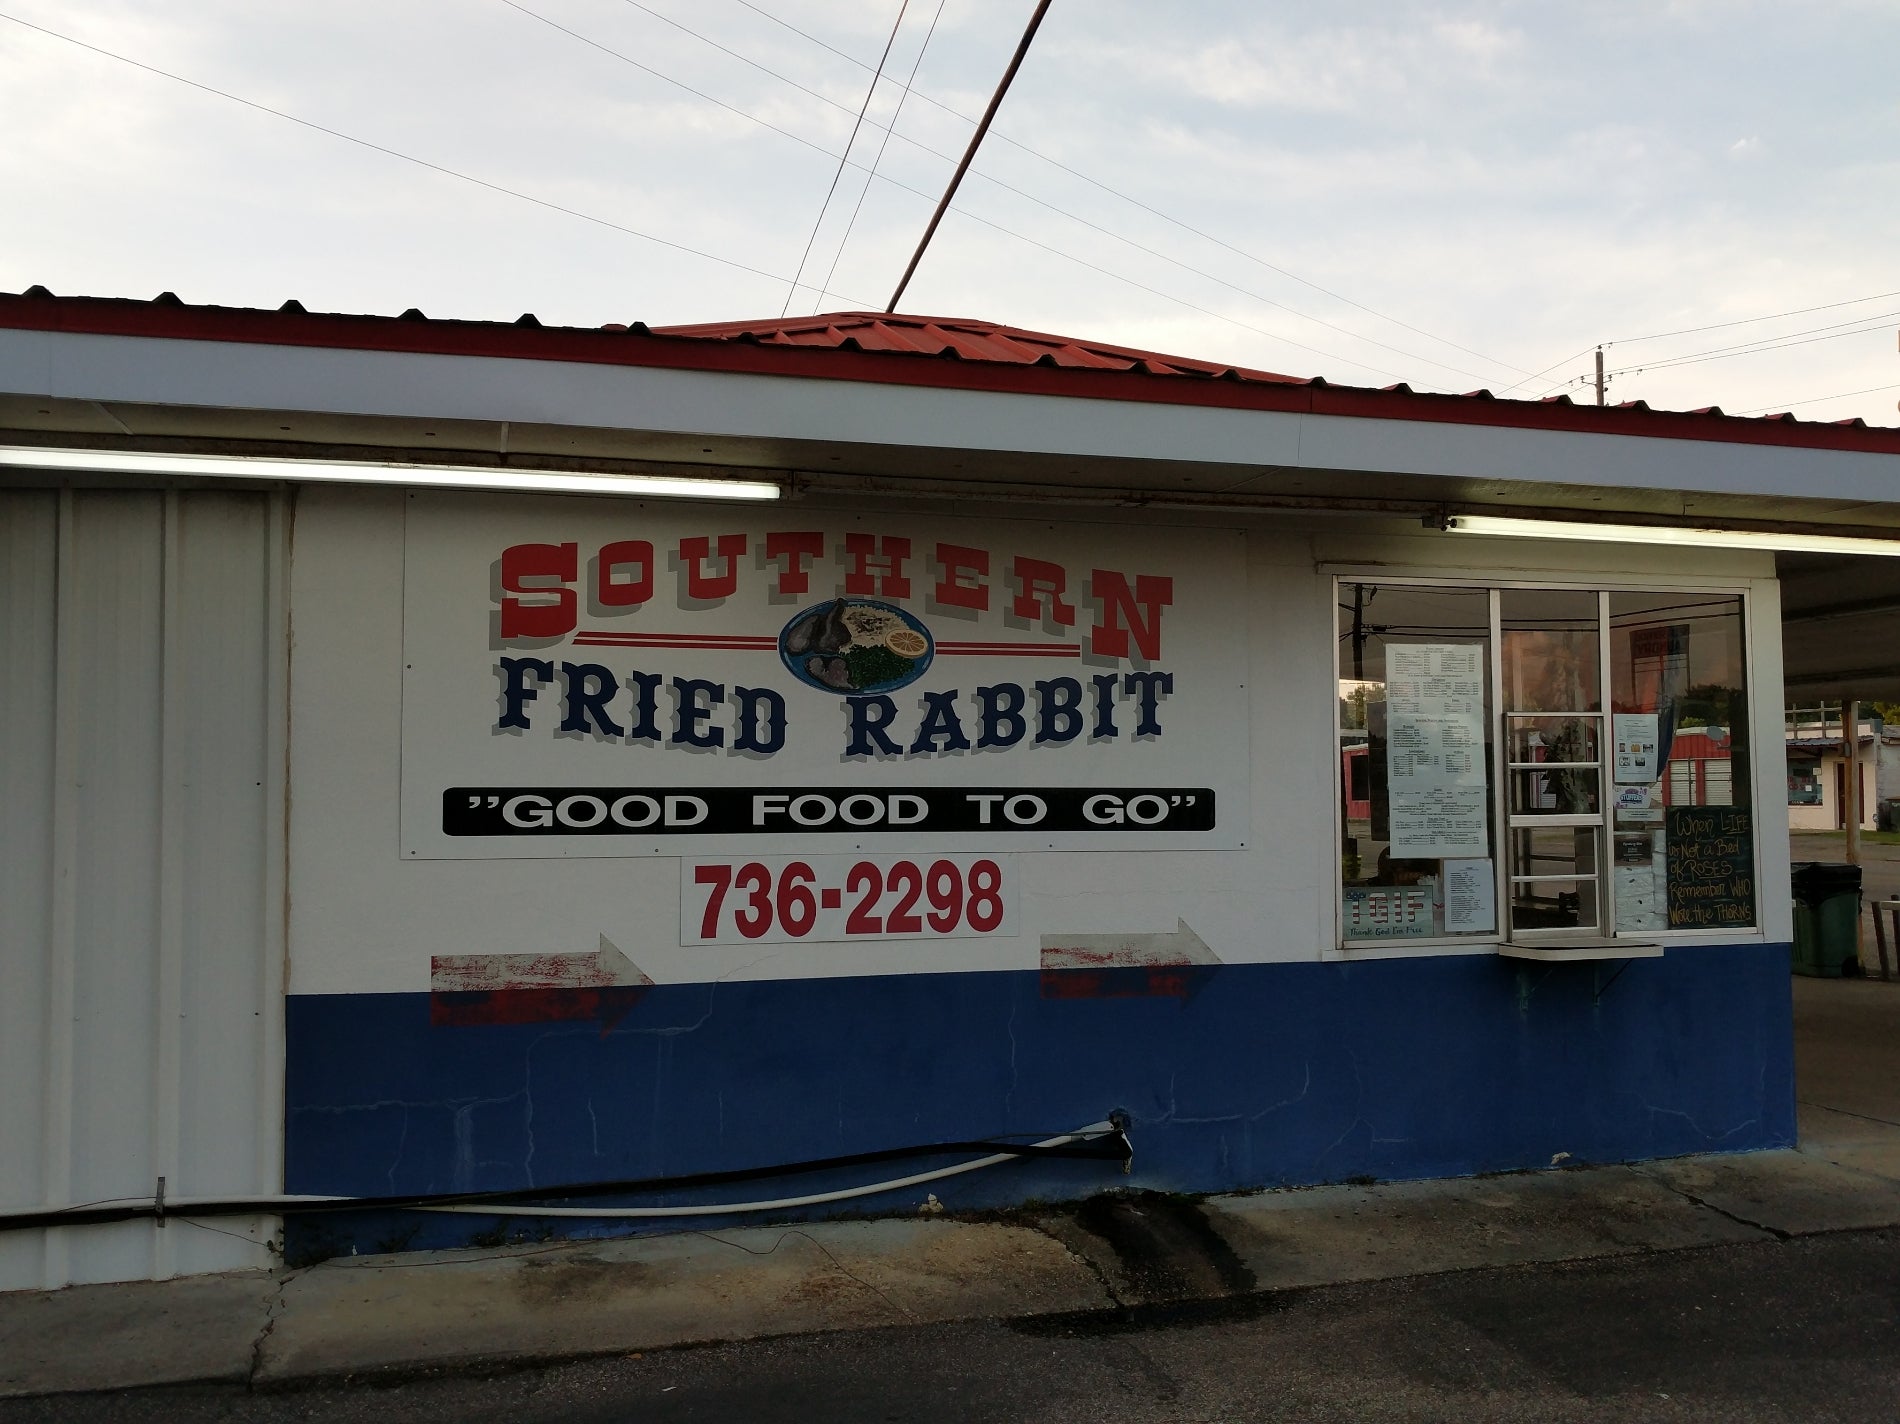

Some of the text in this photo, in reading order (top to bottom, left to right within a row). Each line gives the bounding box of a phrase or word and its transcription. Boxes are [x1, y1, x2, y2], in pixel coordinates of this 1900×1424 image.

[498, 531, 1174, 661] SOUTHERN
[498, 656, 1174, 757] FRIED RABBIT
[752, 794, 929, 826] FOOD
[966, 794, 1047, 825] TO
[1675, 811, 1751, 841] When LIFE
[1681, 839, 1700, 860] Not
[1703, 844, 1713, 856] a
[1713, 838, 1740, 856] Bed
[1670, 859, 1733, 882] of ROSES
[694, 859, 1004, 940] 736-2298
[1729, 876, 1752, 897] WHO
[1346, 890, 1425, 925] TGIF
[1694, 904, 1714, 924] the
[1714, 902, 1752, 921] THORNS
[1350, 927, 1373, 937] Thank
[1375, 927, 1390, 936] God
[1405, 925, 1424, 935] Free
